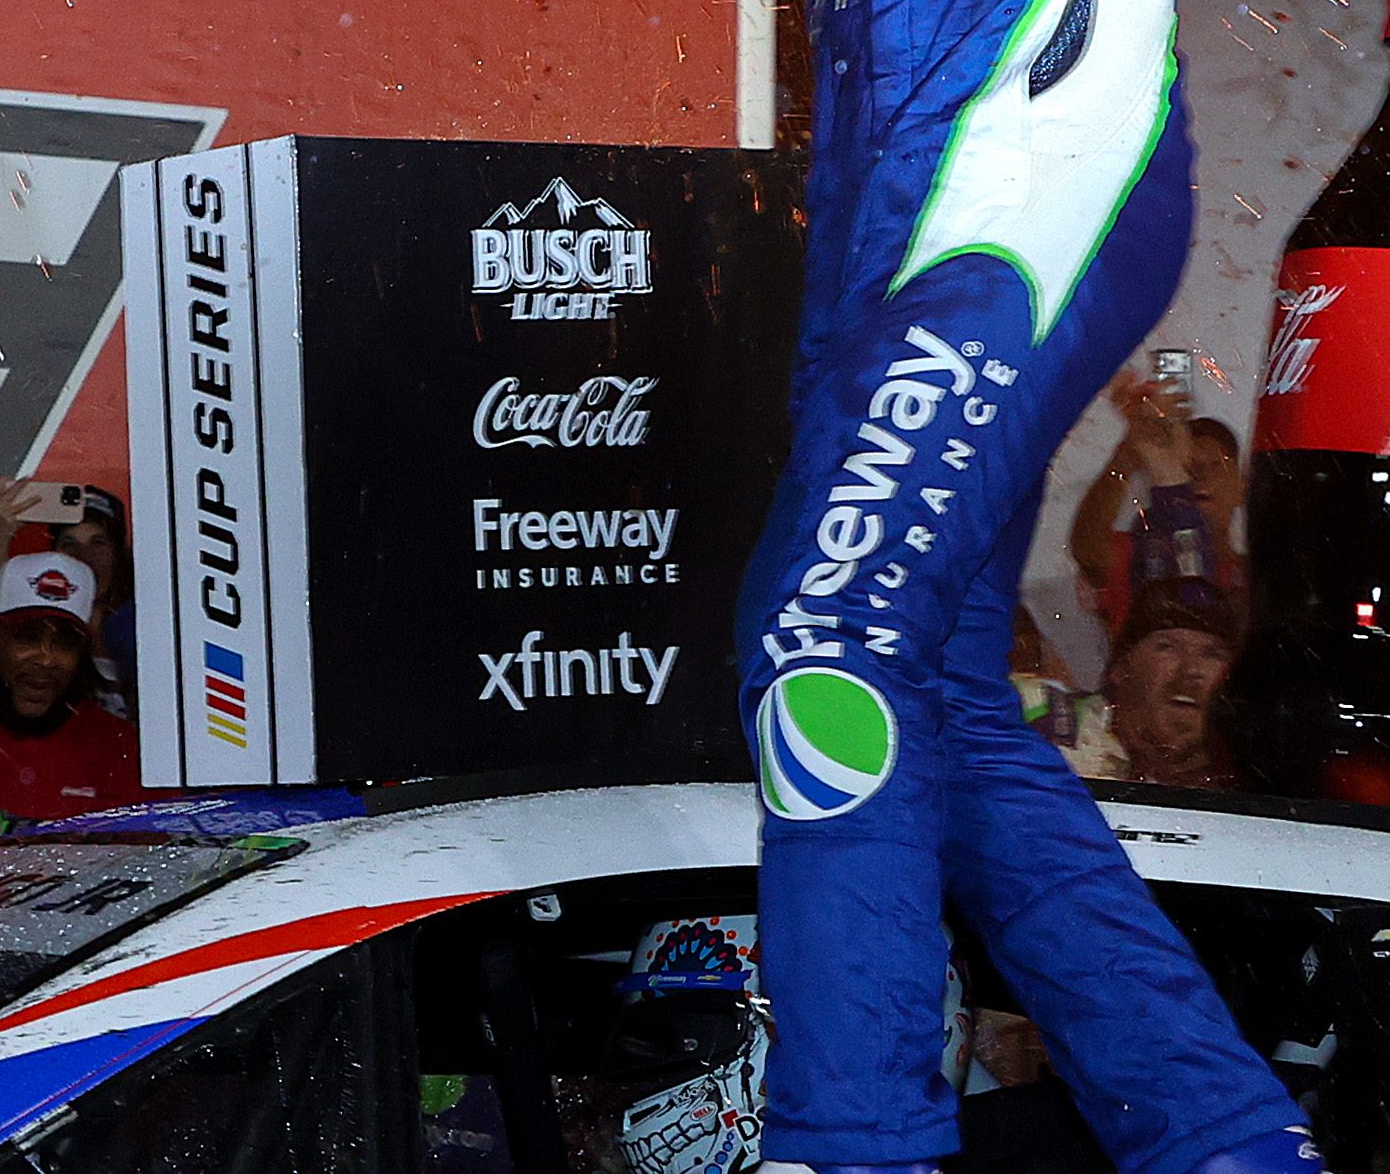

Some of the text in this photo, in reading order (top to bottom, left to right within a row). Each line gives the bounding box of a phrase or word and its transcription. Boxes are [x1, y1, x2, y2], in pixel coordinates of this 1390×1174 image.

[470, 228, 654, 294] BUSCH
[509, 291, 617, 321] LIGHT
[183, 172, 243, 630] CUP SERIES
[472, 375, 661, 450] Coca-Cola
[472, 497, 680, 561] Freeway
[761, 325, 978, 670] Freeway
[476, 562, 681, 590] INSURANCE
[478, 629, 681, 712] xfinity
